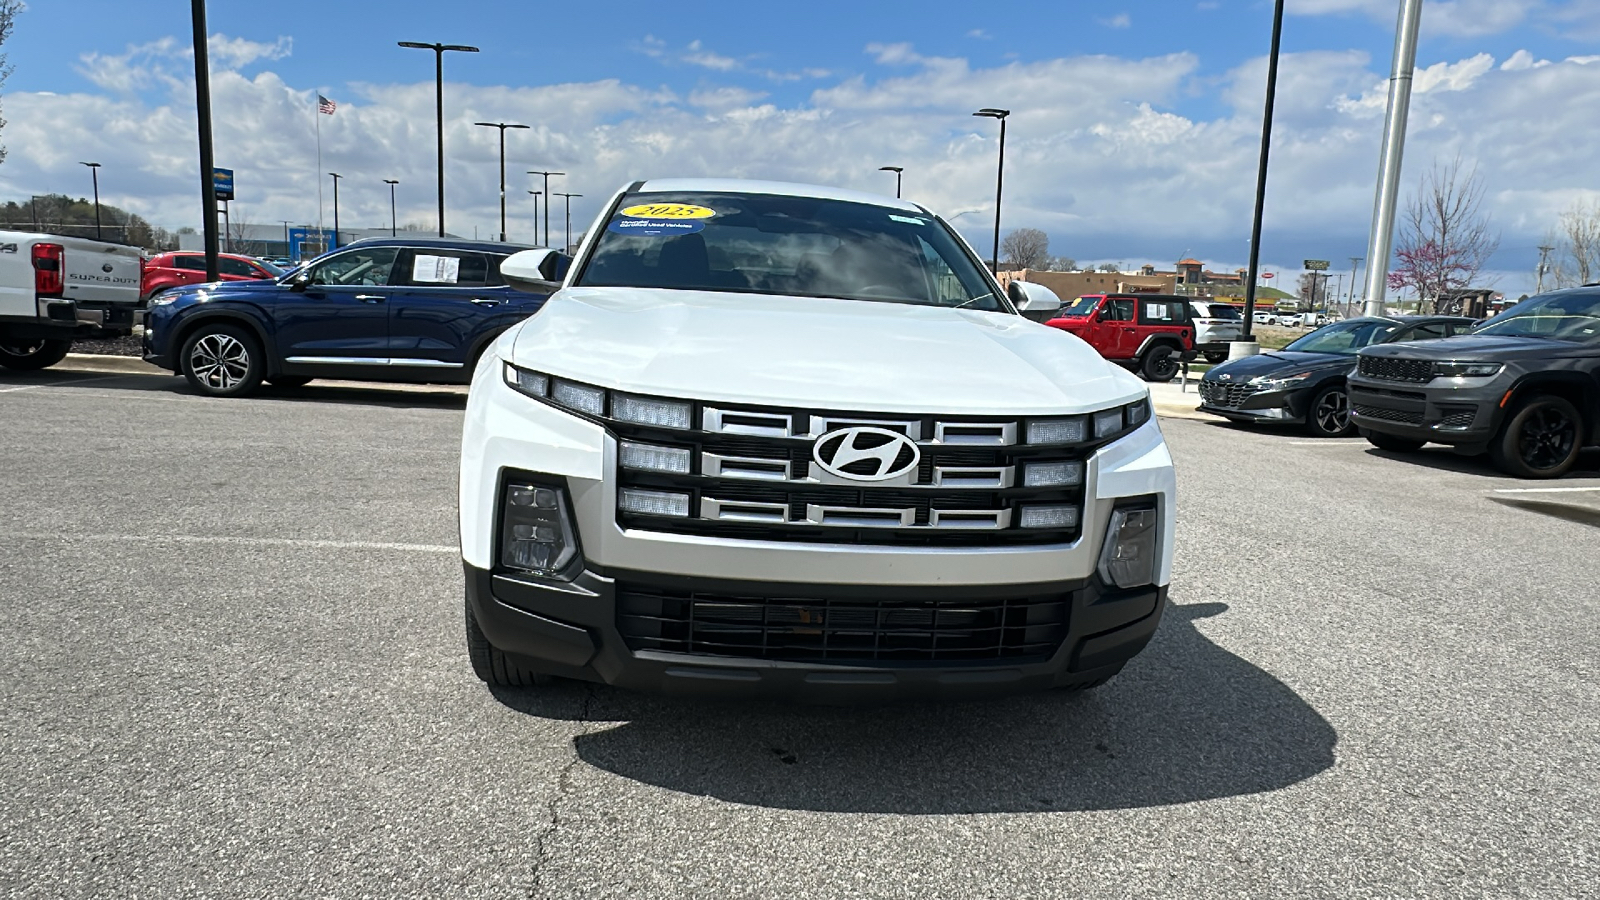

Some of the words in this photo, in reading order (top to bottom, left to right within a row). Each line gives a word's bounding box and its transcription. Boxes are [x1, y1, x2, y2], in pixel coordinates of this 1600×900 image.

[633, 206, 701, 216] 2025
[69, 273, 111, 283] SUPER
[112, 276, 138, 284] DUTY
